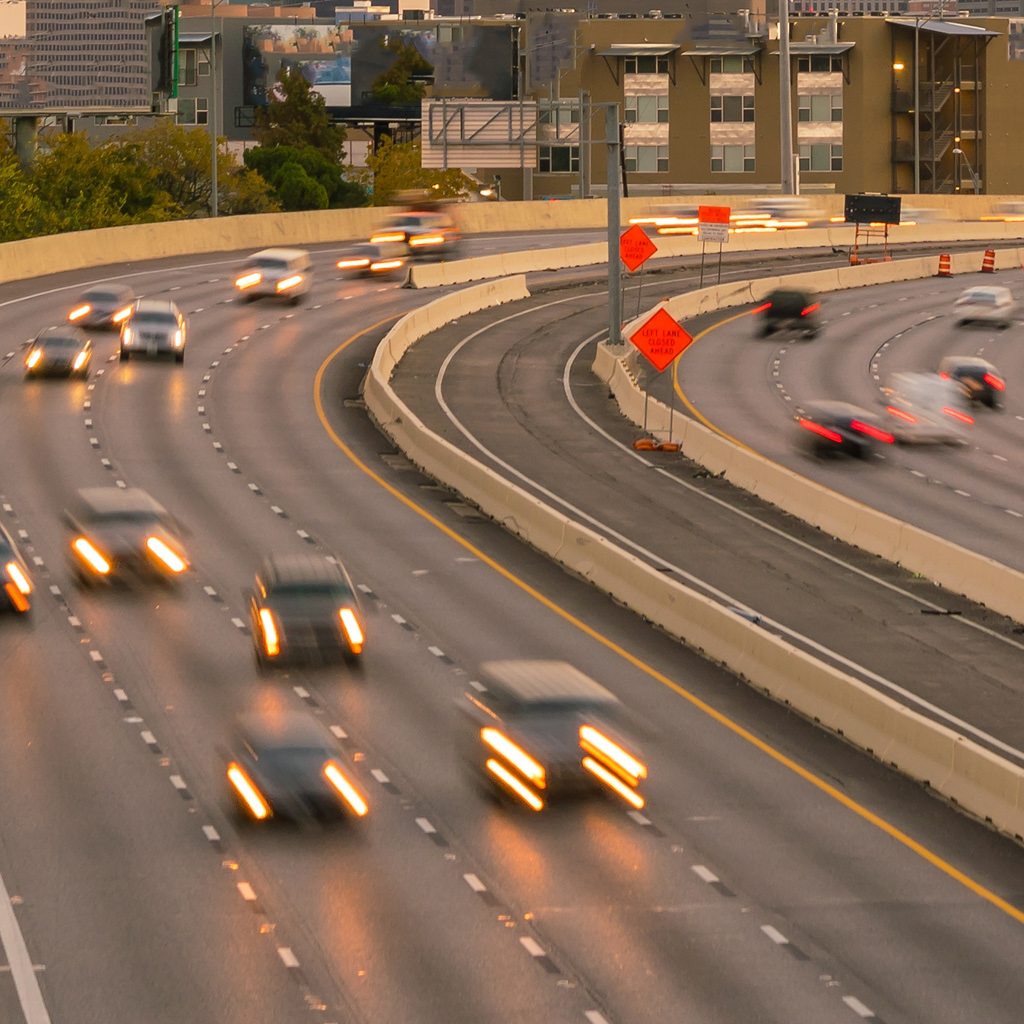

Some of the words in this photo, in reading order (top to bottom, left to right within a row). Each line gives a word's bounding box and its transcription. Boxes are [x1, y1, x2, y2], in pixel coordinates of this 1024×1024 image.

[642, 329, 659, 337] LEFT
[648, 338, 675, 346] CLOSED
[650, 347, 674, 355] AHEAD
